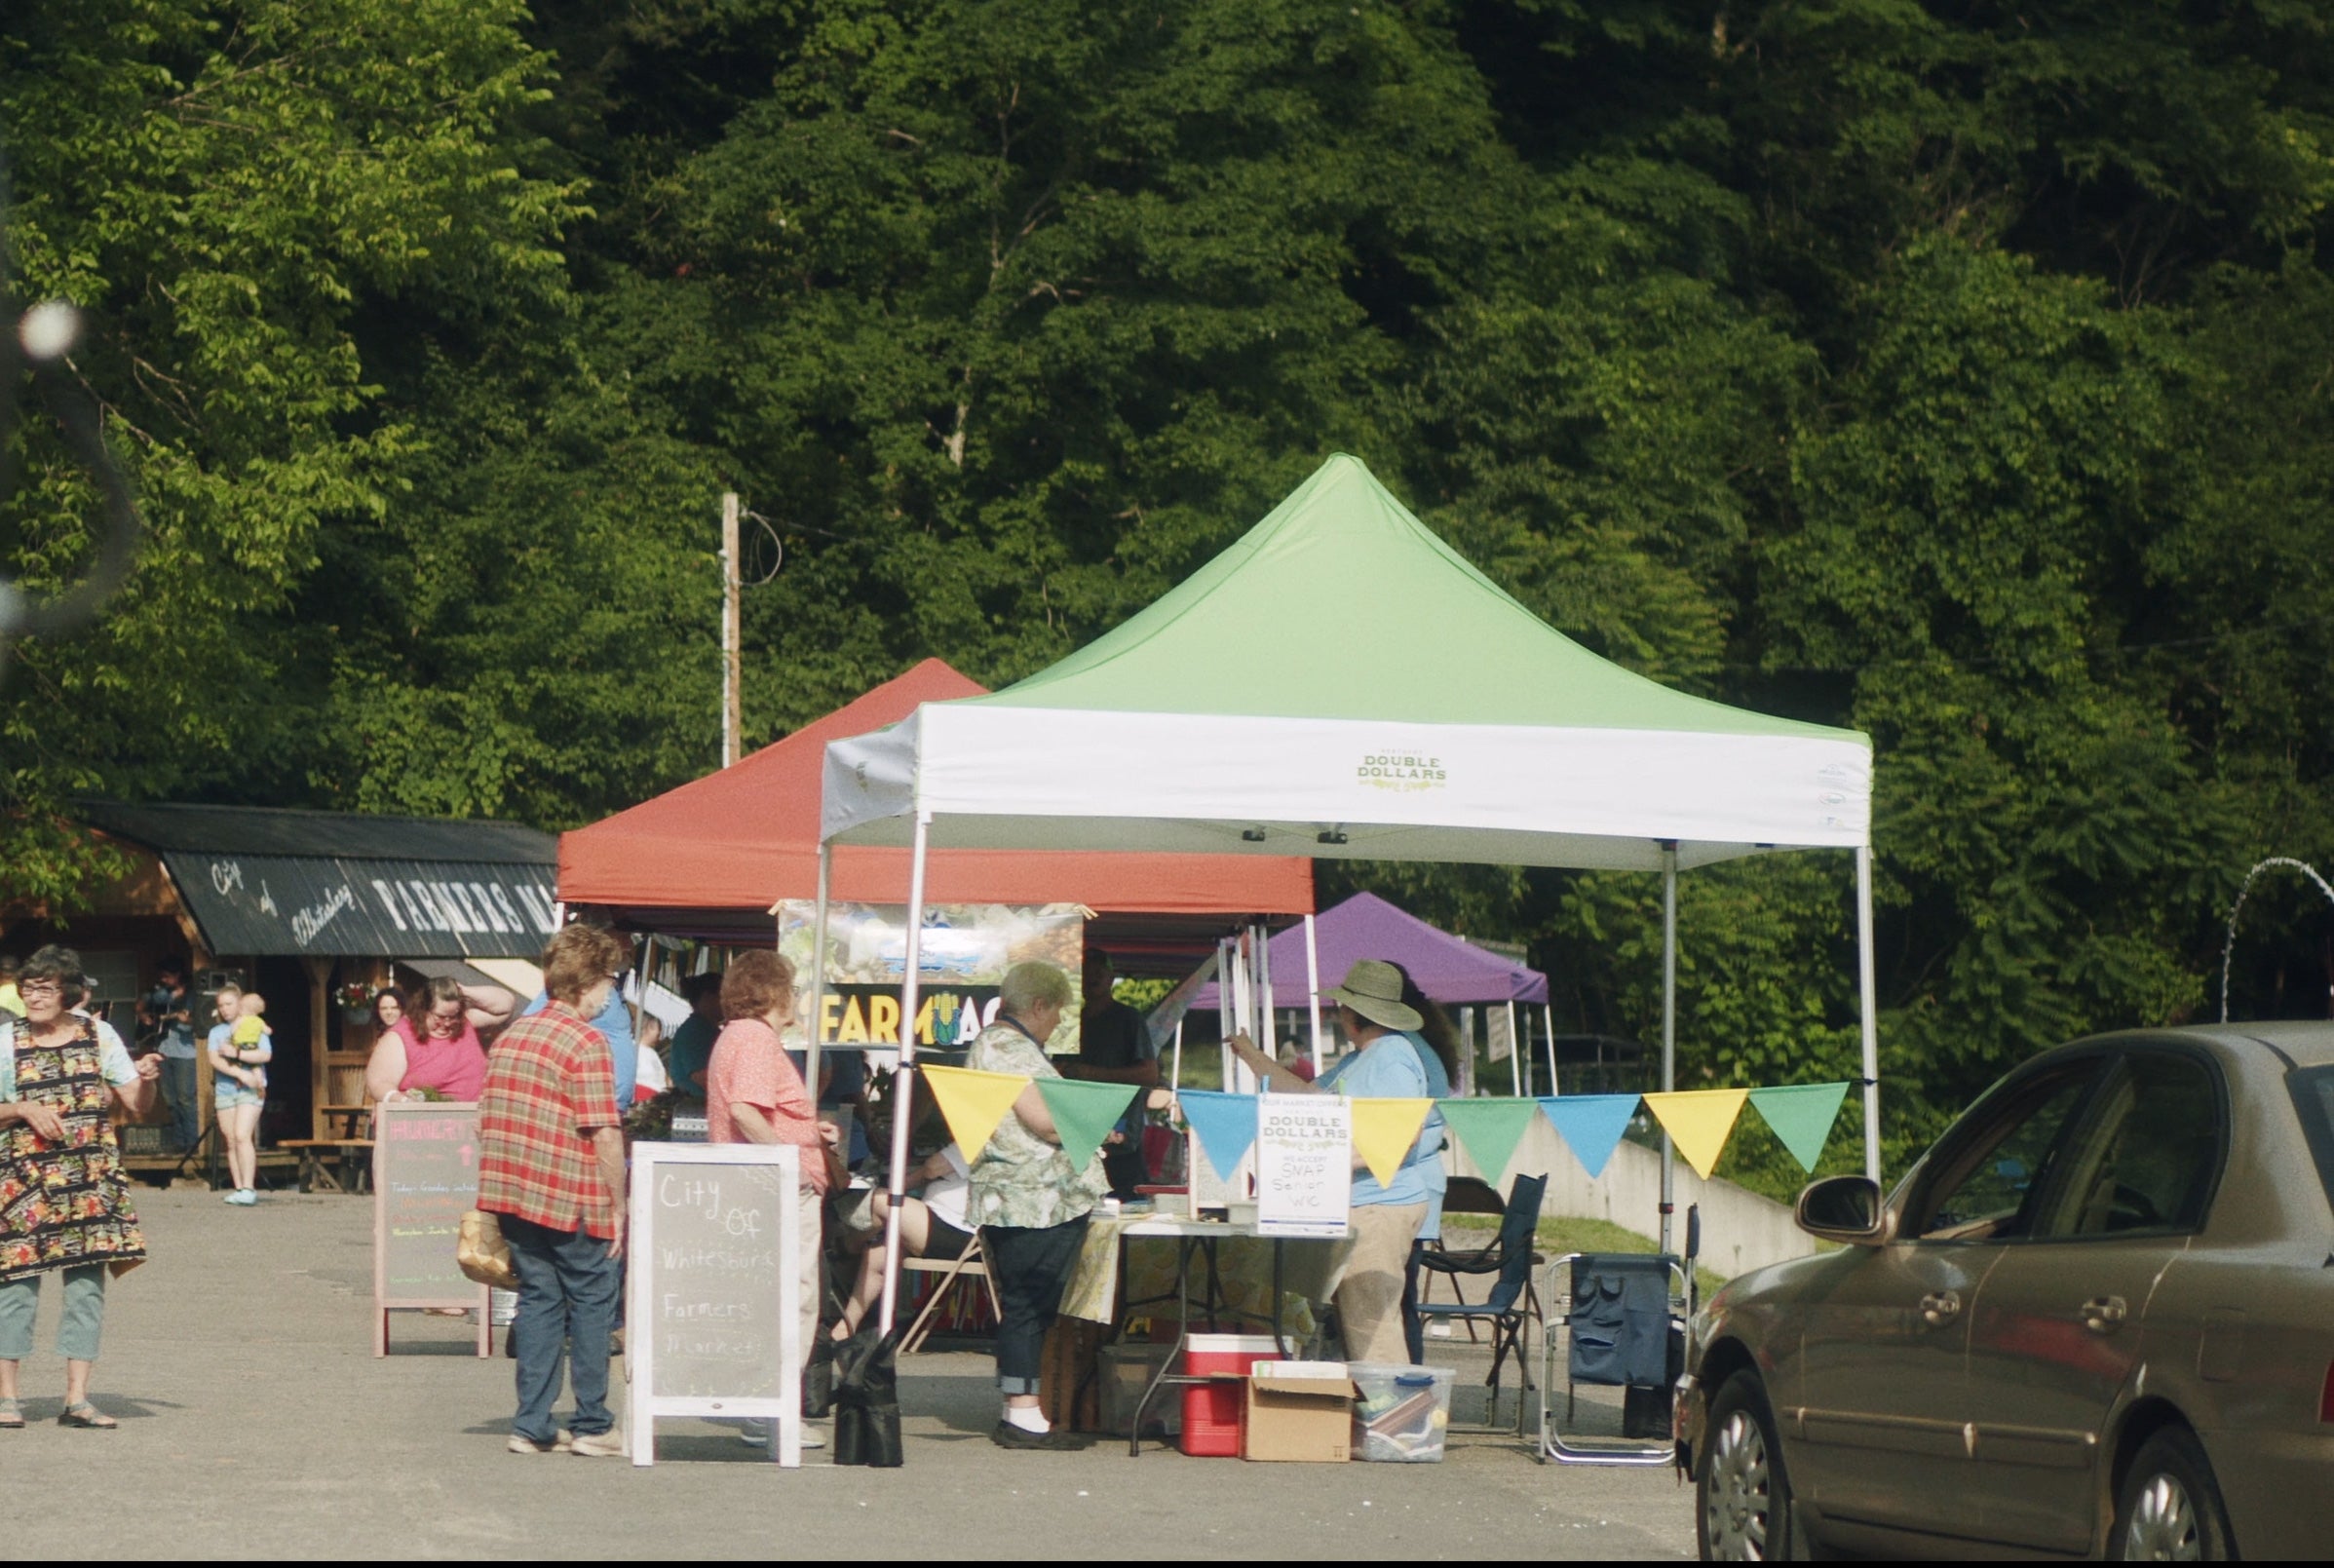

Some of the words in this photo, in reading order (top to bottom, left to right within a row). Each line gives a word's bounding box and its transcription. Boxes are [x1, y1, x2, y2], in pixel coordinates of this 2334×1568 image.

[1364, 755, 1440, 768] DOUBLE
[1358, 767, 1446, 780] DOLLARS
[371, 879, 524, 934] FARMERS
[1269, 1116, 1341, 1127] DOUBLE
[1263, 1127, 1348, 1138] DOLLARS
[1282, 1163, 1325, 1177] SNAP
[660, 1173, 720, 1219] City
[664, 1293, 750, 1318] Farmers
